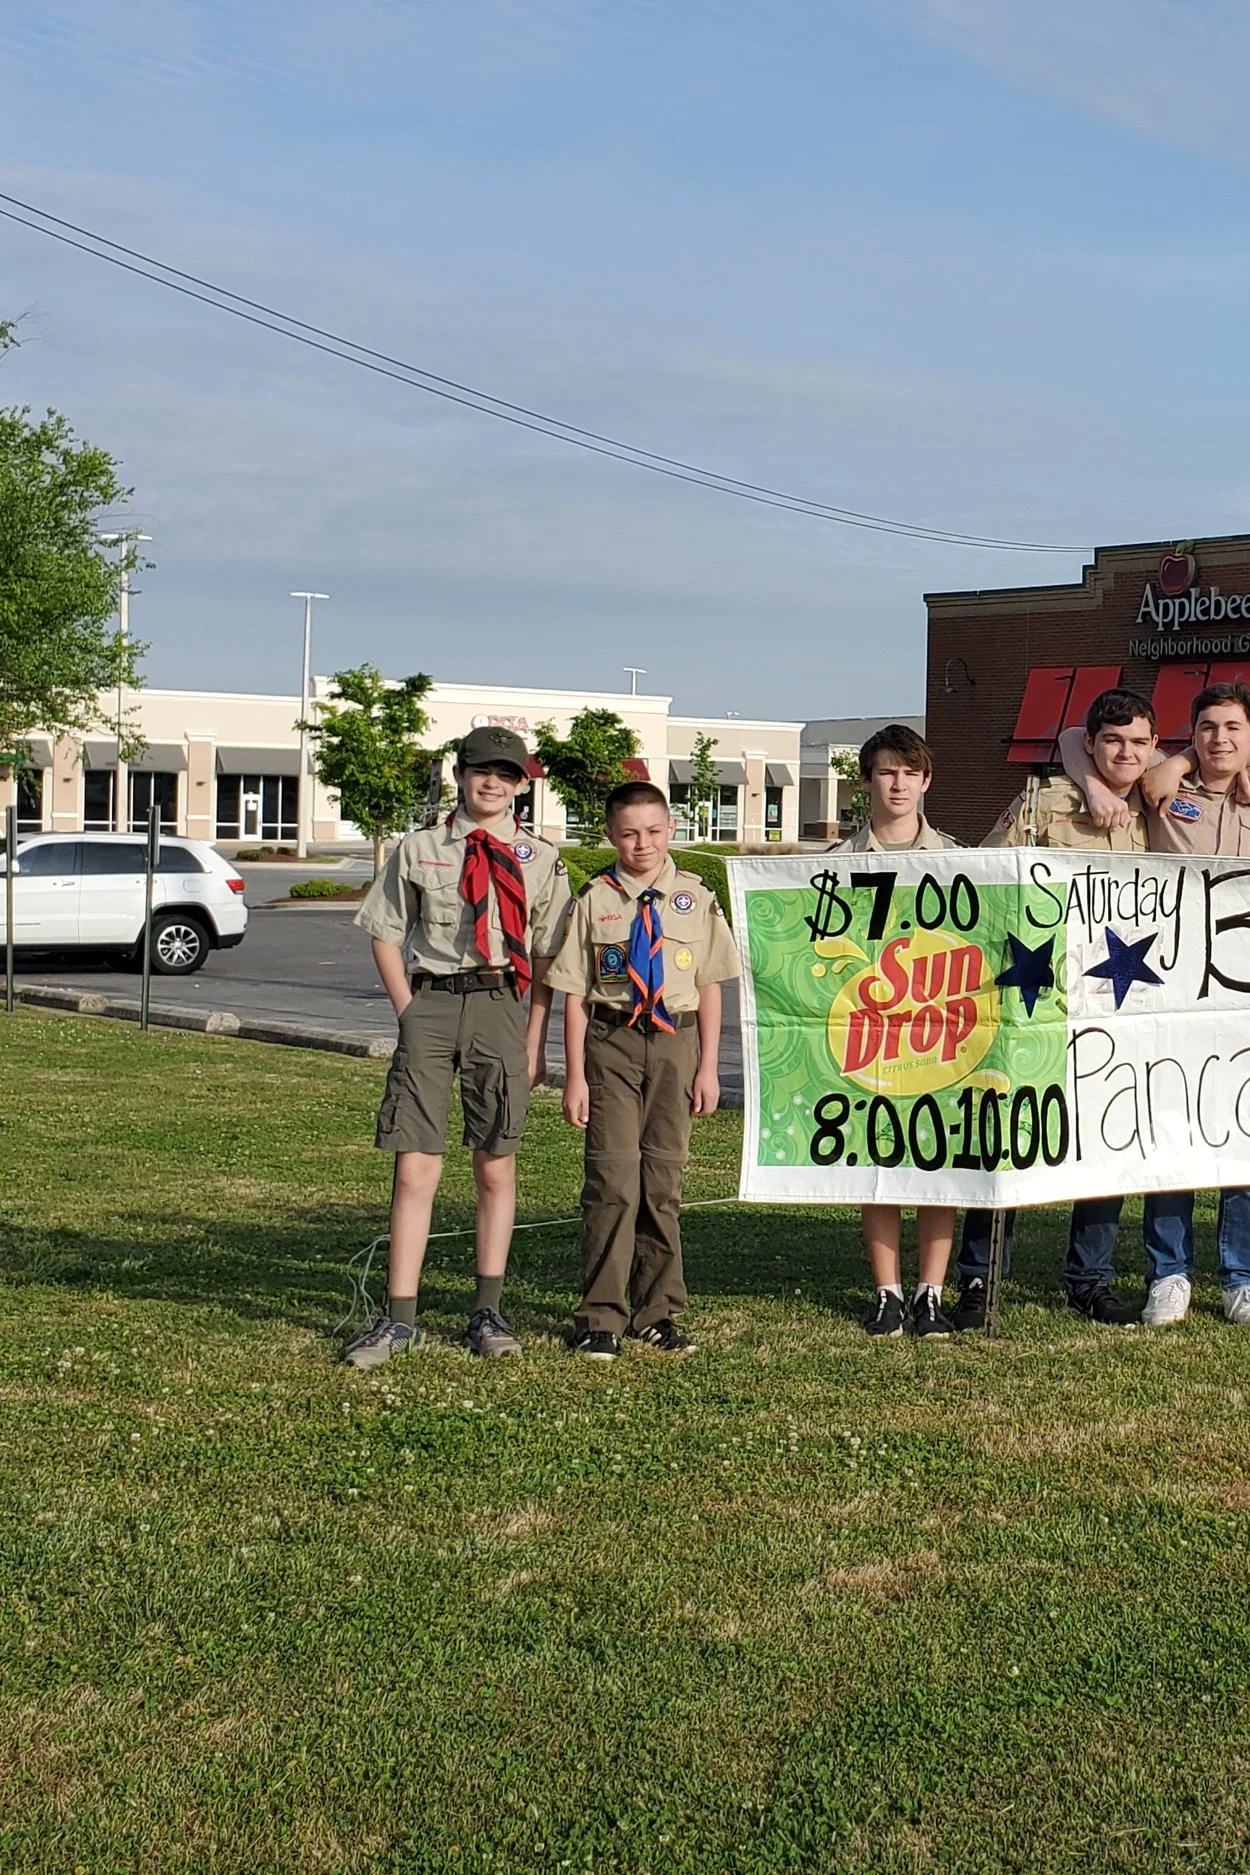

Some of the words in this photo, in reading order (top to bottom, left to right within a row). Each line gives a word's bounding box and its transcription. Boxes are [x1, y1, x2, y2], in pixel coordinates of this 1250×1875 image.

[1129, 635, 1231, 660] Neighborhood
[804, 869, 980, 942] $7.00
[858, 937, 983, 1011] Sun
[842, 996, 978, 1073] Drop
[882, 1061, 914, 1074] CITRUS
[915, 1056, 938, 1069] SODA
